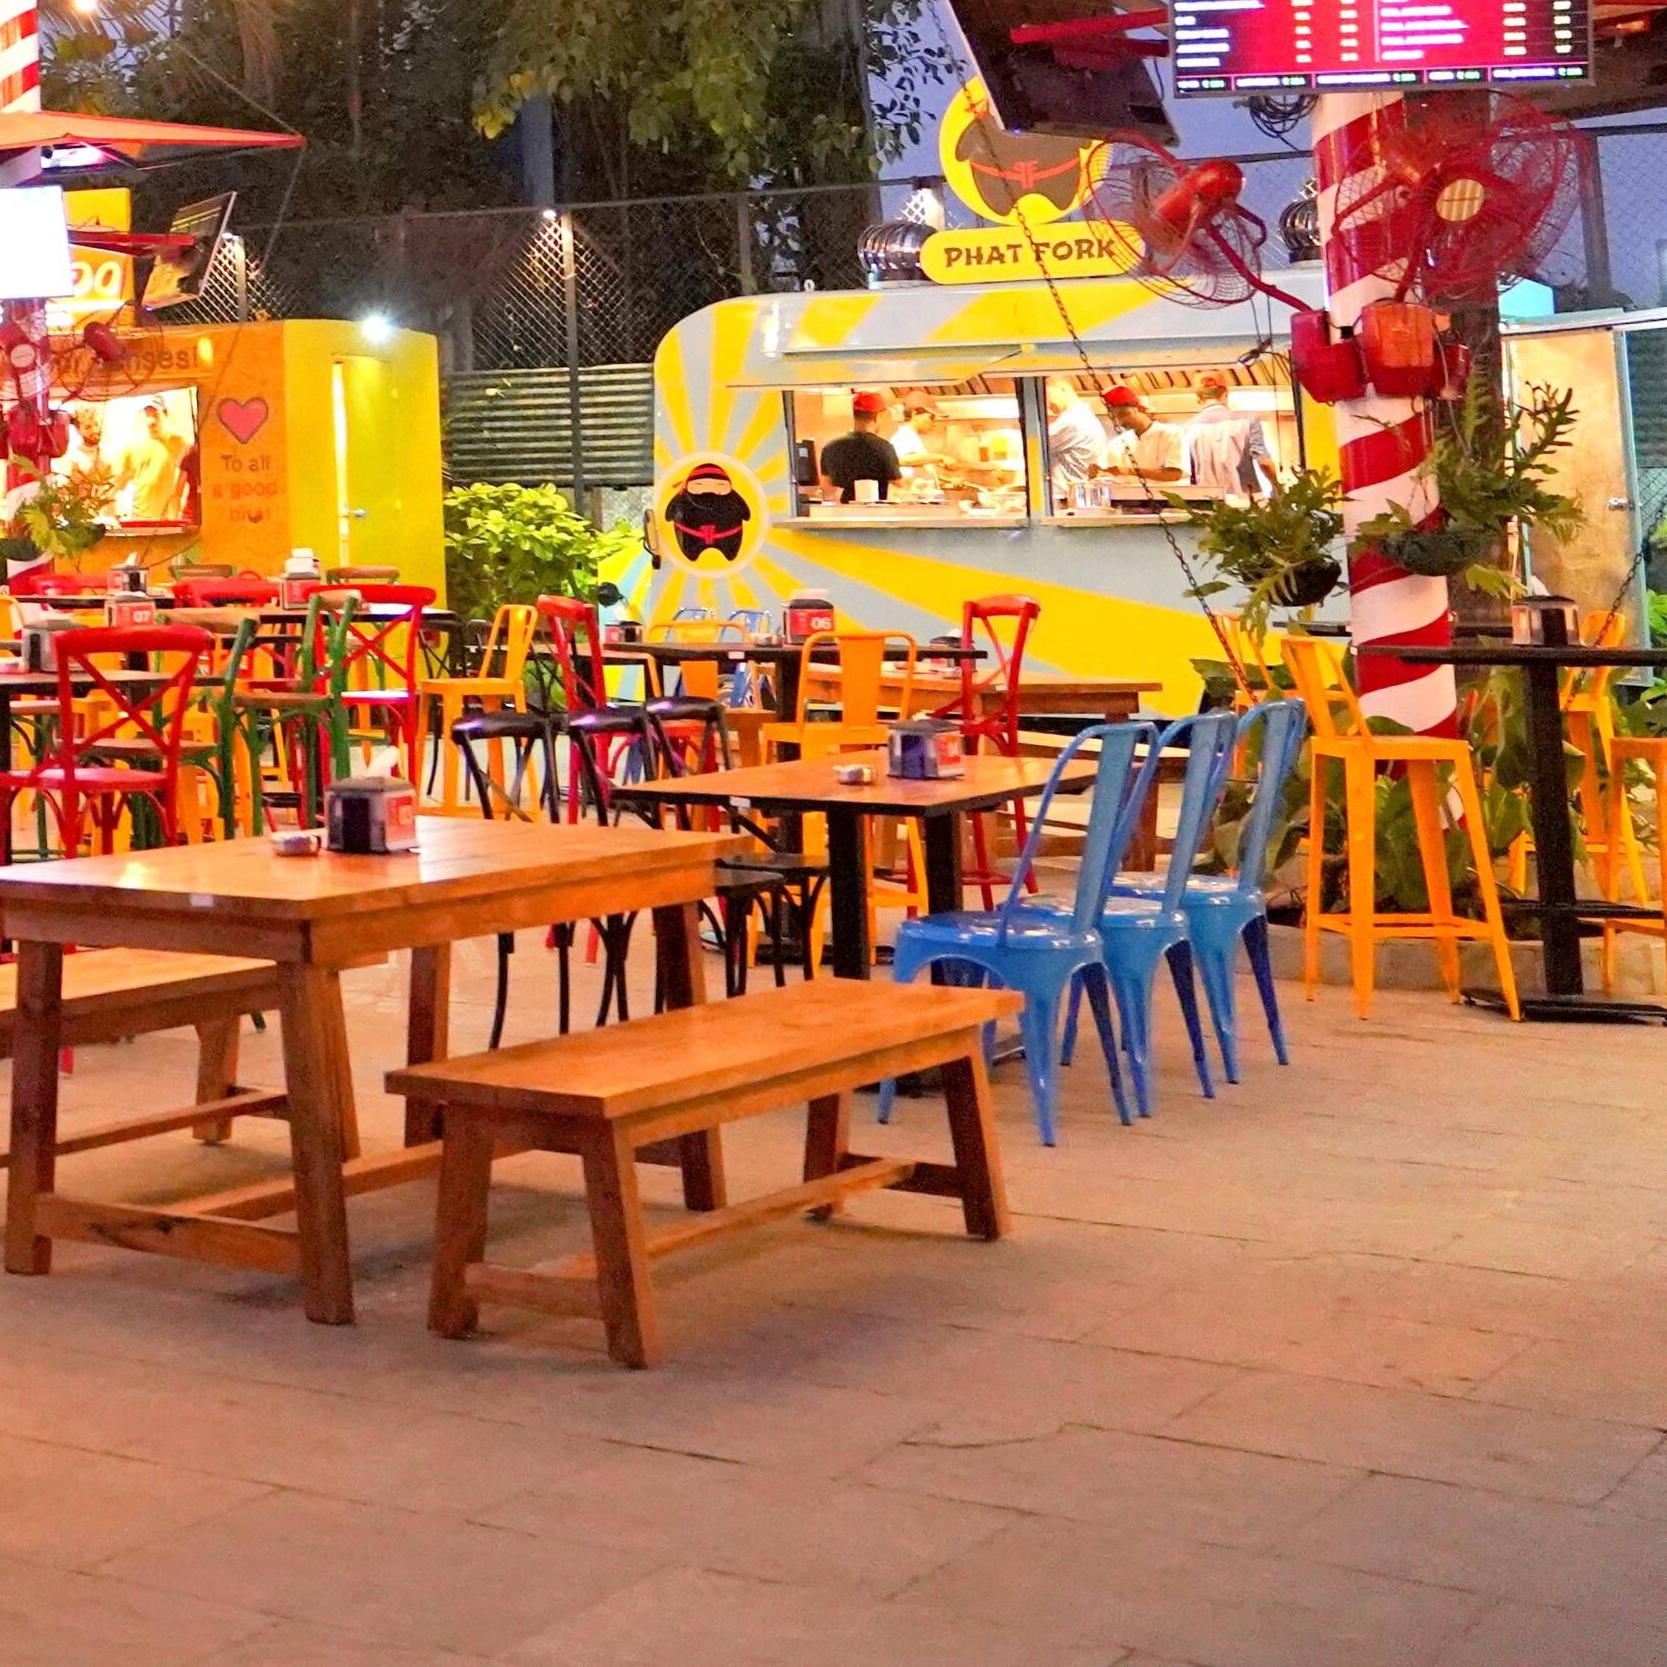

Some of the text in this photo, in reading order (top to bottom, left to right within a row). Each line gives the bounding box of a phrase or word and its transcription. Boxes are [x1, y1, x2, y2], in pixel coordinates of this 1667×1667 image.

[945, 238, 1115, 267] PHAT FORK
[221, 454, 270, 472] To all
[133, 611, 150, 624] 07
[811, 615, 830, 630] 06
